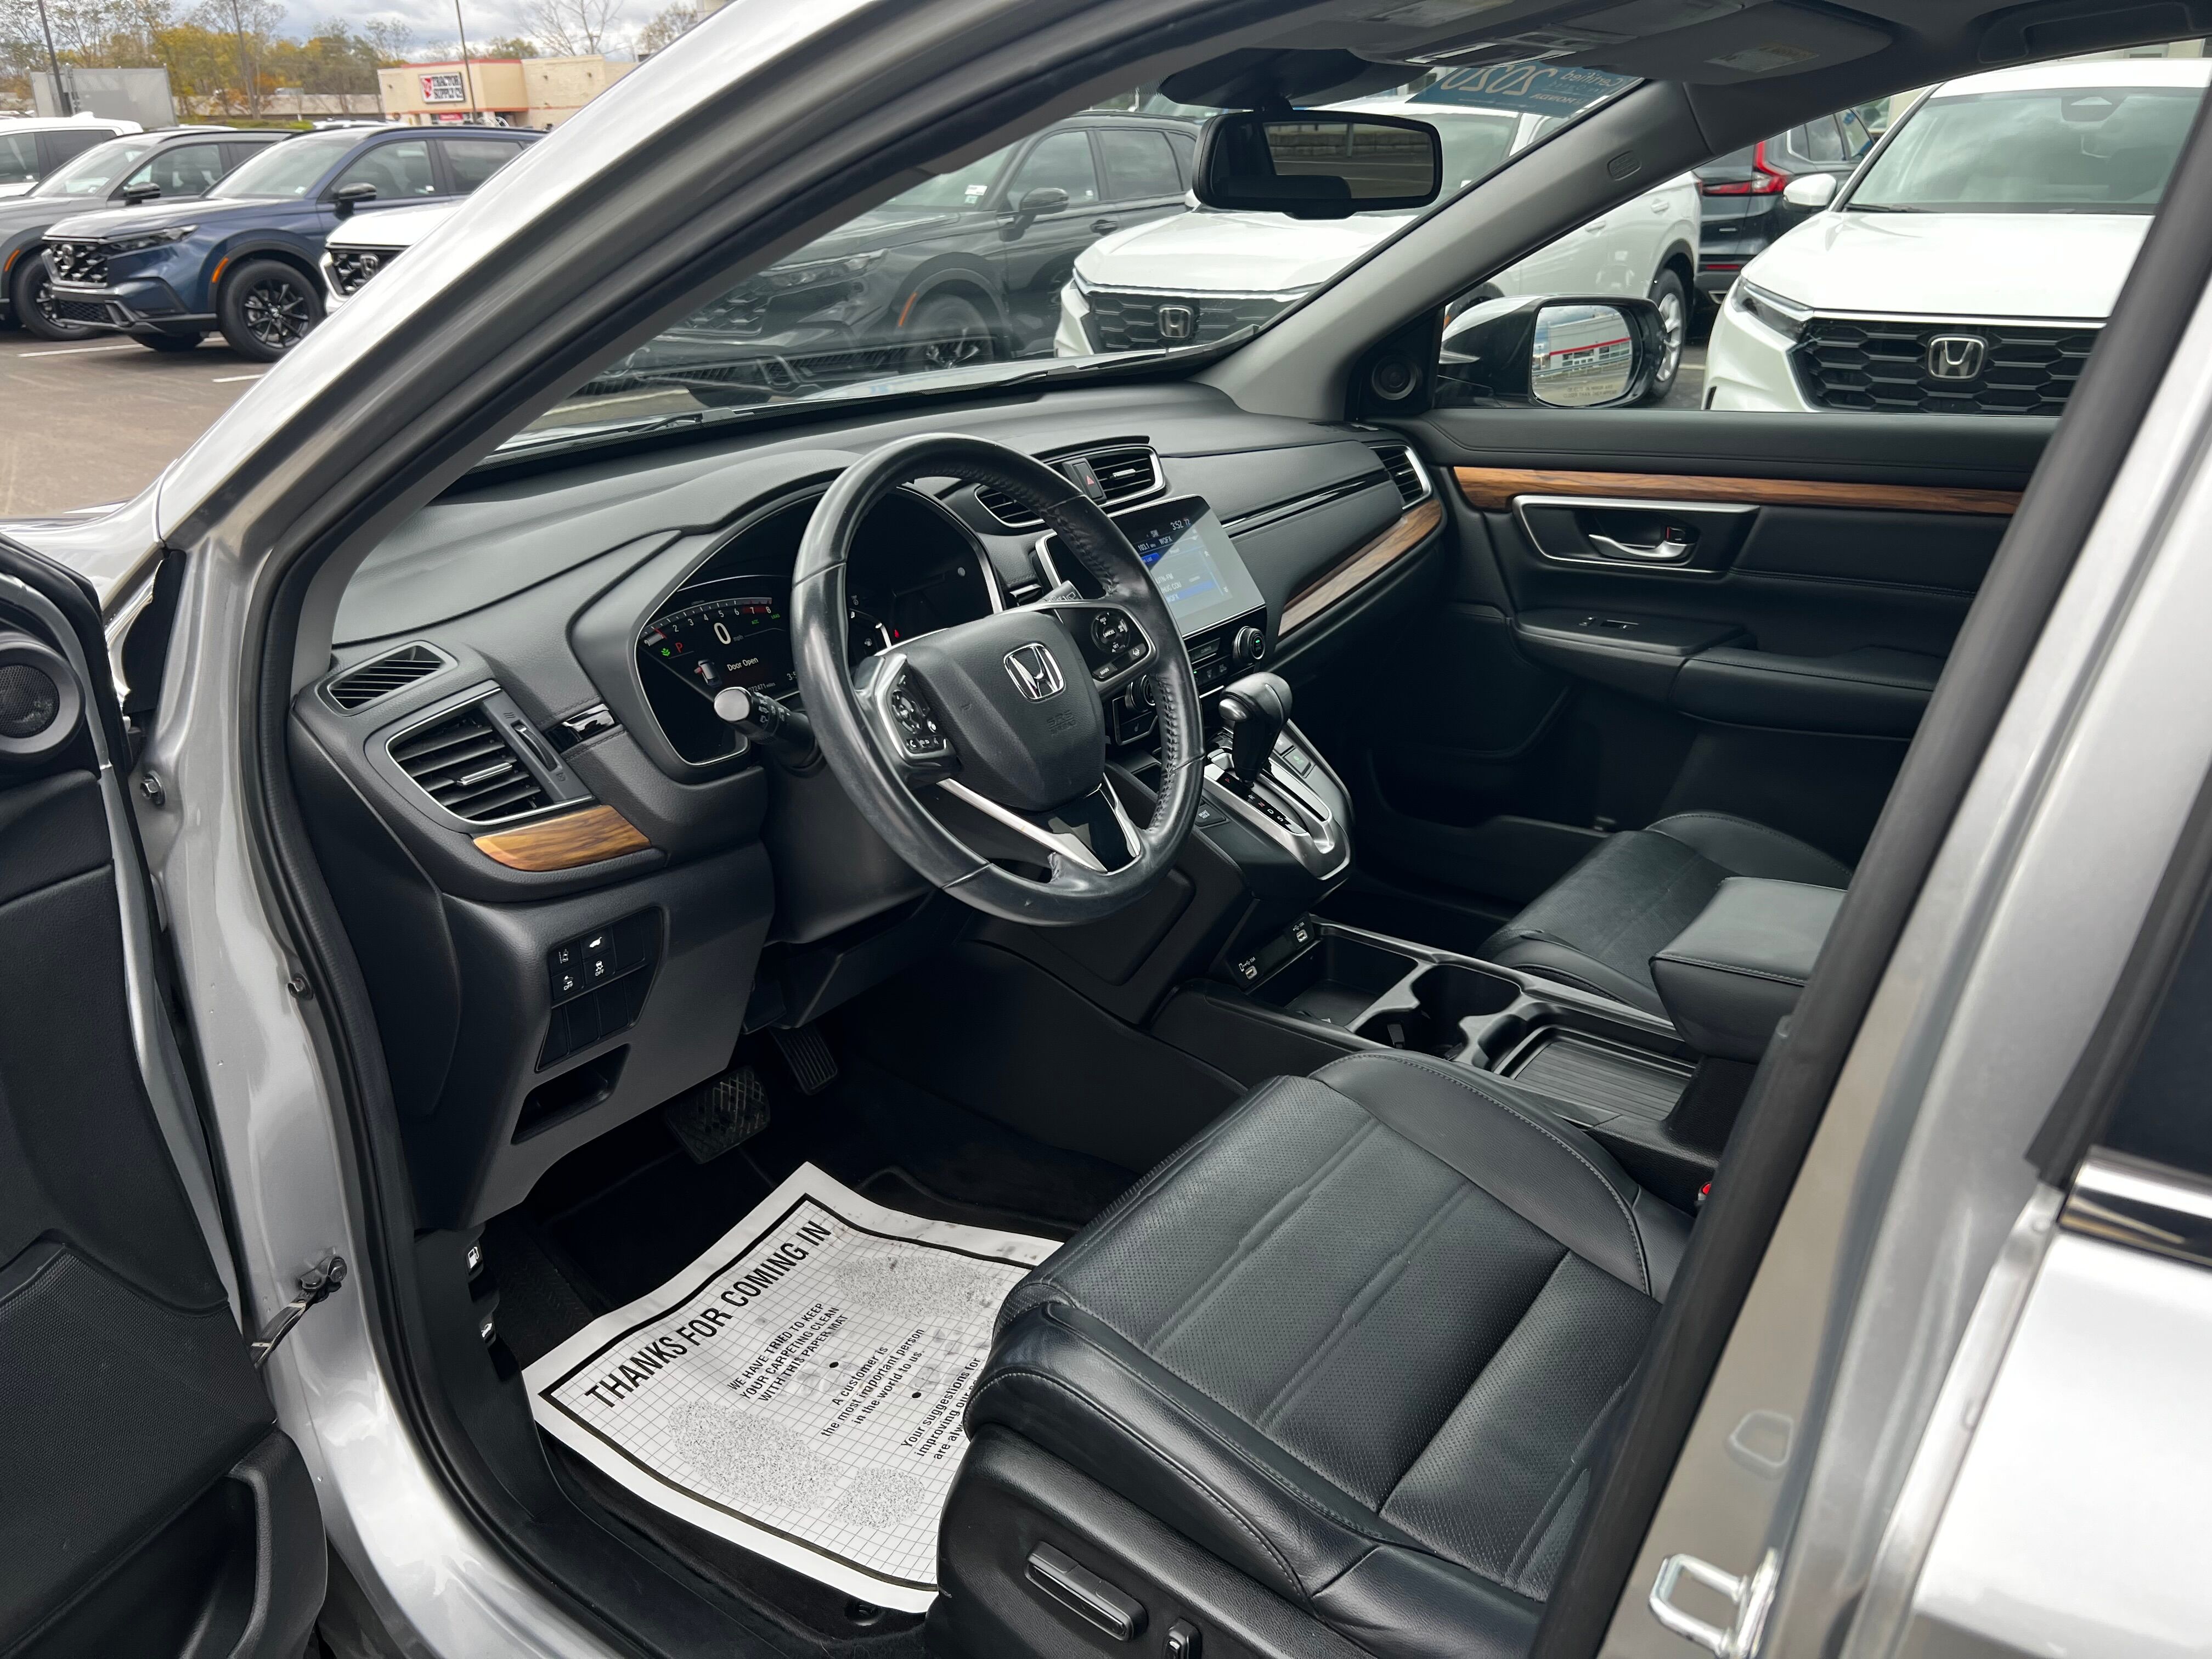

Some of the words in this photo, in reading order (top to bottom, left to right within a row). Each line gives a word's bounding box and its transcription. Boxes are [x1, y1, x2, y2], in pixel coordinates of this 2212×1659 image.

[1137, 543, 1150, 551] 103.1
[1170, 520, 1184, 531] 3:52
[675, 642, 684, 653] P
[714, 622, 731, 645] 0
[727, 662, 742, 672] Door
[742, 657, 759, 667] Open
[563, 982, 573, 991] OFF
[584, 1336, 687, 1408] THANKS
[675, 1307, 733, 1346] FOR
[720, 1243, 809, 1307] COMING
[796, 1220, 832, 1246] IN
[727, 1377, 747, 1390] WE
[742, 1355, 769, 1379] HAVE
[764, 1331, 793, 1354] TRIED
[789, 1321, 805, 1332] TO
[801, 1303, 824, 1322] KEEP
[740, 1375, 769, 1400] YOUR
[765, 1331, 814, 1374] CARPETING
[810, 1307, 840, 1330] CLEAN
[758, 1377, 786, 1401] WITH
[781, 1357, 805, 1378] THIS
[801, 1331, 832, 1357] PAPER
[828, 1314, 849, 1330] MAT
[840, 1355, 879, 1397] customer
[874, 1347, 888, 1355] is
[821, 1422, 840, 1436] the
[837, 1398, 861, 1421] most
[856, 1356, 899, 1398] important
[896, 1329, 925, 1356] person
[851, 1414, 866, 1424] in
[861, 1400, 880, 1414] the
[877, 1373, 903, 1398] world
[898, 1363, 912, 1372] to
[909, 1351, 925, 1362] us.
[900, 1426, 926, 1447] Your
[922, 1372, 970, 1425] suggestions
[964, 1358, 981, 1370] for
[913, 1409, 960, 1457] improving
[956, 1392, 969, 1408] our
[933, 1444, 950, 1460] are
[947, 1421, 963, 1442] alw
